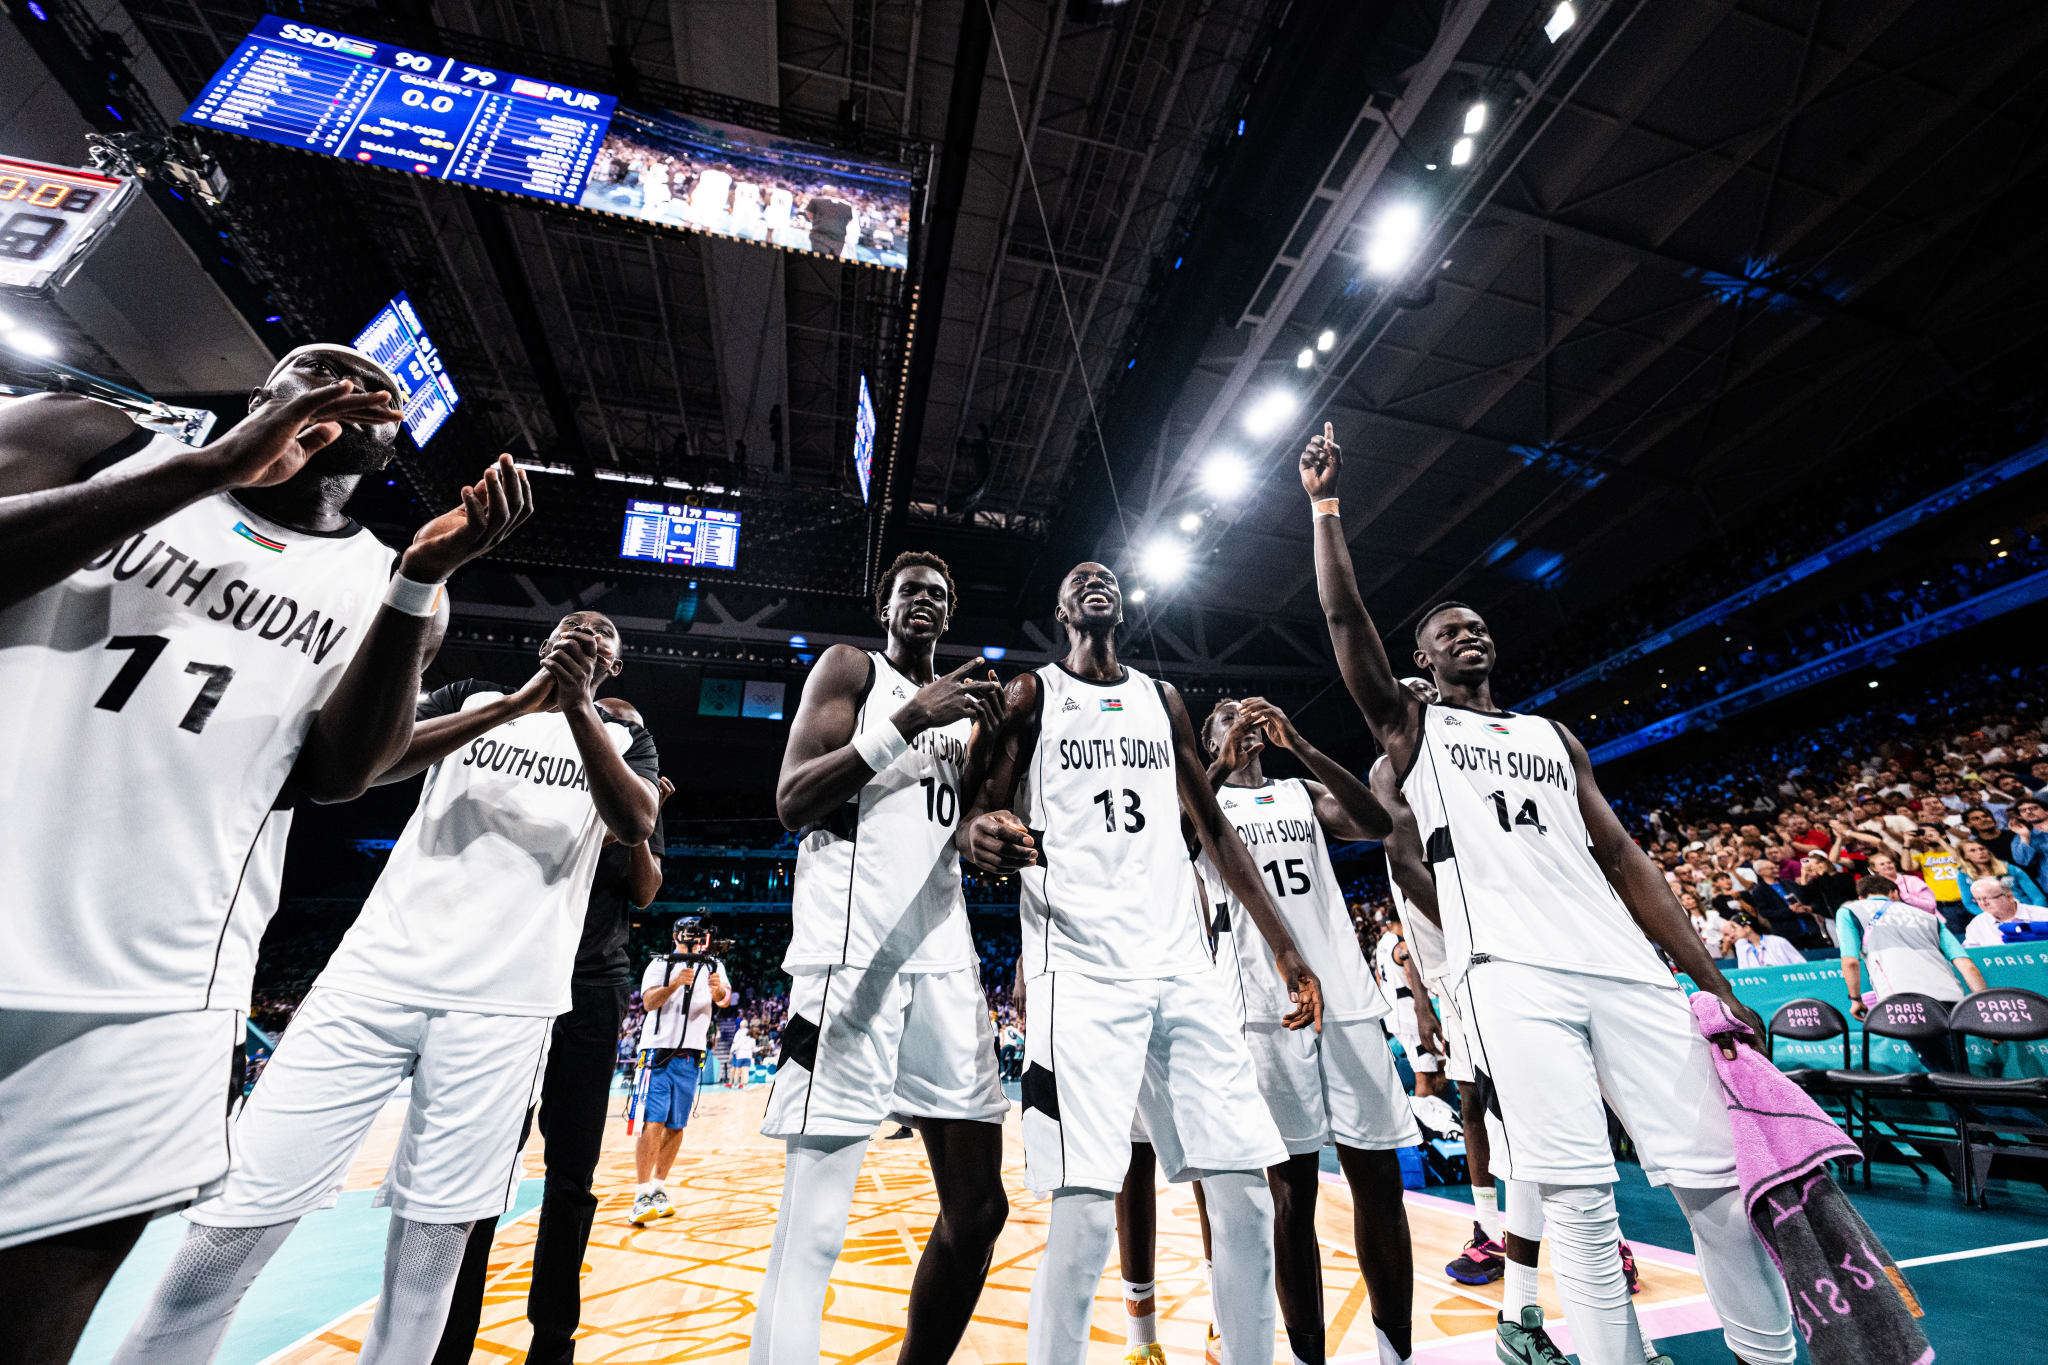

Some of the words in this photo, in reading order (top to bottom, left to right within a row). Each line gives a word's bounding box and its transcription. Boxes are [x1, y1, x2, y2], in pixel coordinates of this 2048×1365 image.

[279, 24, 337, 49] SSD
[395, 52, 432, 72] 90
[460, 67, 497, 86] 79
[402, 89, 454, 113] 0.0
[546, 87, 600, 111] PUR
[207, 579, 348, 665] SUDAN
[94, 634, 236, 735] 11
[463, 737, 539, 779] SOUTH
[533, 756, 590, 792] SUDA
[940, 733, 970, 775] SUDA
[1060, 738, 1116, 770] SOUTH
[1119, 736, 1170, 770] SUDAN
[1507, 751, 1568, 791] SUDAN
[920, 776, 955, 827] 10
[1093, 788, 1146, 834] 13
[1485, 790, 1548, 836] 14
[1236, 821, 1278, 848] OUTH
[1262, 858, 1312, 897] 15
[1931, 866, 1957, 881] 23
[1983, 954, 2035, 967] PARIS
[1782, 972, 1818, 982] PARIS
[1819, 970, 1845, 980] 202
[1786, 1007, 1820, 1018] PARIS
[1885, 1002, 1924, 1014] PARIS
[1975, 999, 2027, 1011] PARIS
[1980, 1011, 2033, 1023] 2024
[1788, 1017, 1821, 1027] 2024
[1888, 1014, 1927, 1025] 2024
[1786, 1044, 1826, 1054] PARIS
